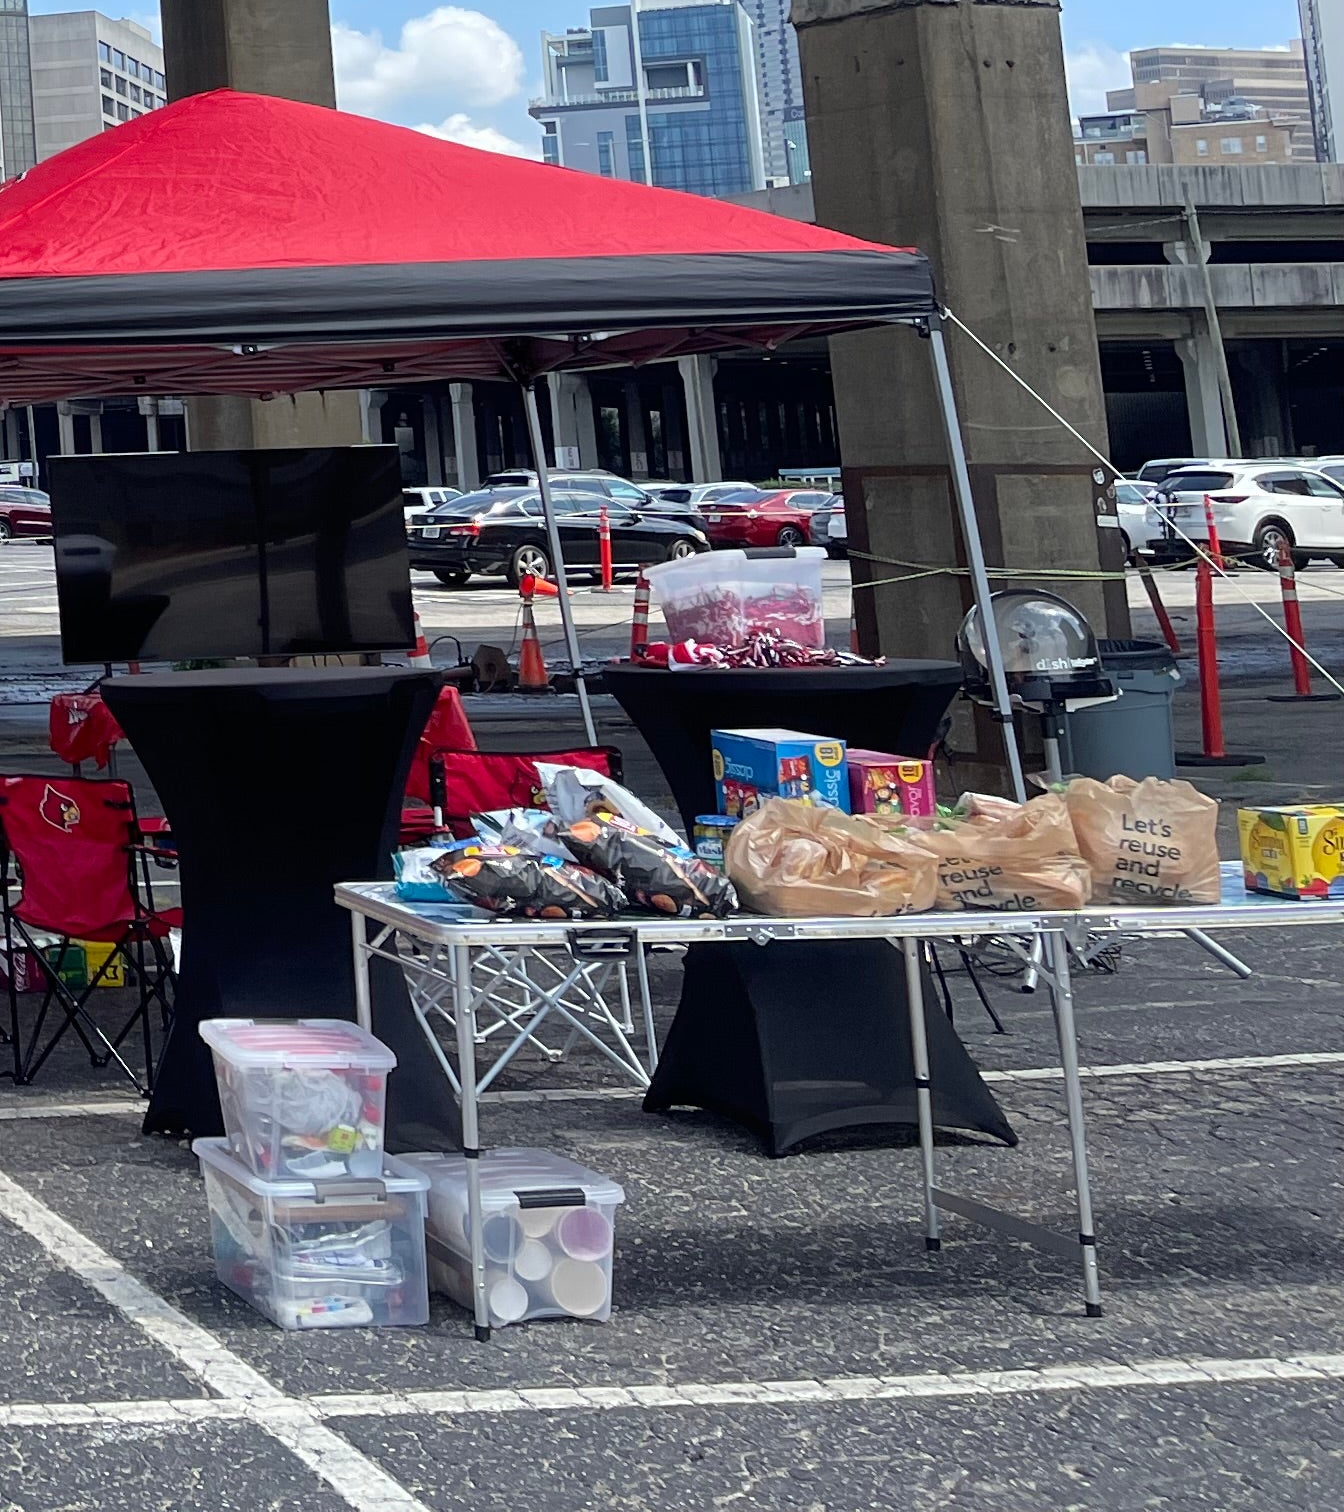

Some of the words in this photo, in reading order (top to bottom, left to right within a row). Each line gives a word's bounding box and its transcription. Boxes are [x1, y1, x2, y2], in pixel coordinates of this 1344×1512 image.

[1122, 813, 1172, 838] Let's
[1119, 838, 1182, 861] reuse
[939, 866, 1004, 887] reuse
[1115, 857, 1161, 878] and
[951, 879, 993, 903] and
